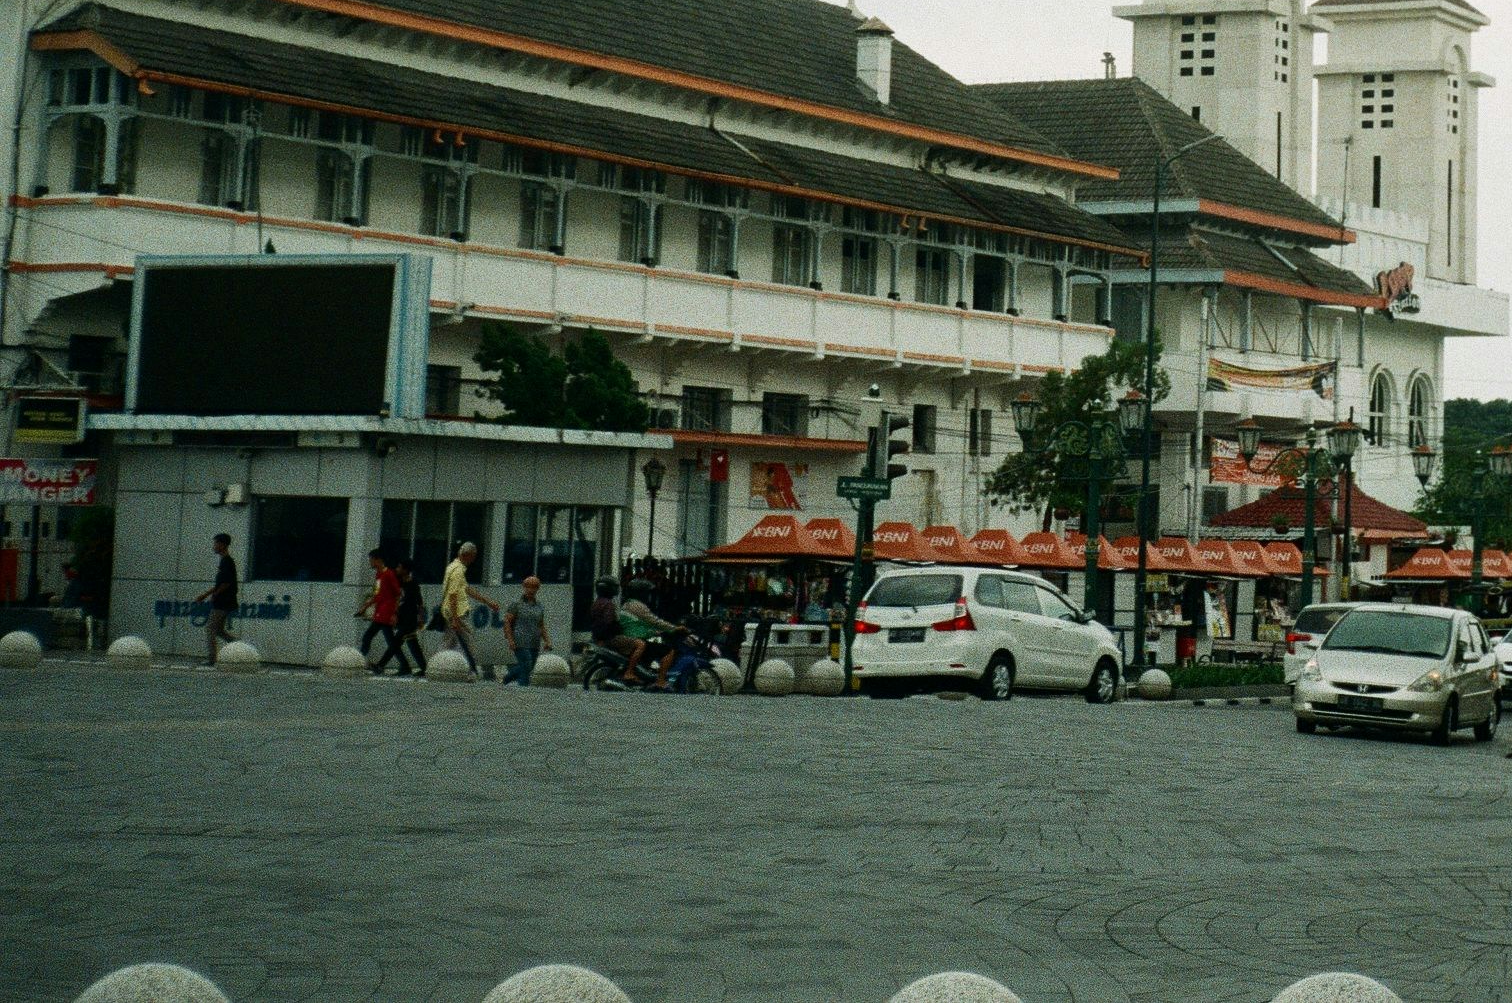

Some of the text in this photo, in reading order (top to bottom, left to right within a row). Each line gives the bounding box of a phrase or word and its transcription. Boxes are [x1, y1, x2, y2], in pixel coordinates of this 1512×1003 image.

[3, 466, 90, 483] MONEY
[0, 485, 89, 502] ANGER
[765, 526, 791, 538] BNI
[812, 529, 839, 540] BNI
[883, 532, 909, 542] BNI
[929, 536, 955, 547] BNI
[981, 540, 1005, 550] BNI
[1030, 544, 1053, 554] BNI
[1120, 547, 1140, 557] BN
[1162, 548, 1185, 557] BNI
[1201, 551, 1225, 560] BNI
[1421, 558, 1441, 566] BNI
